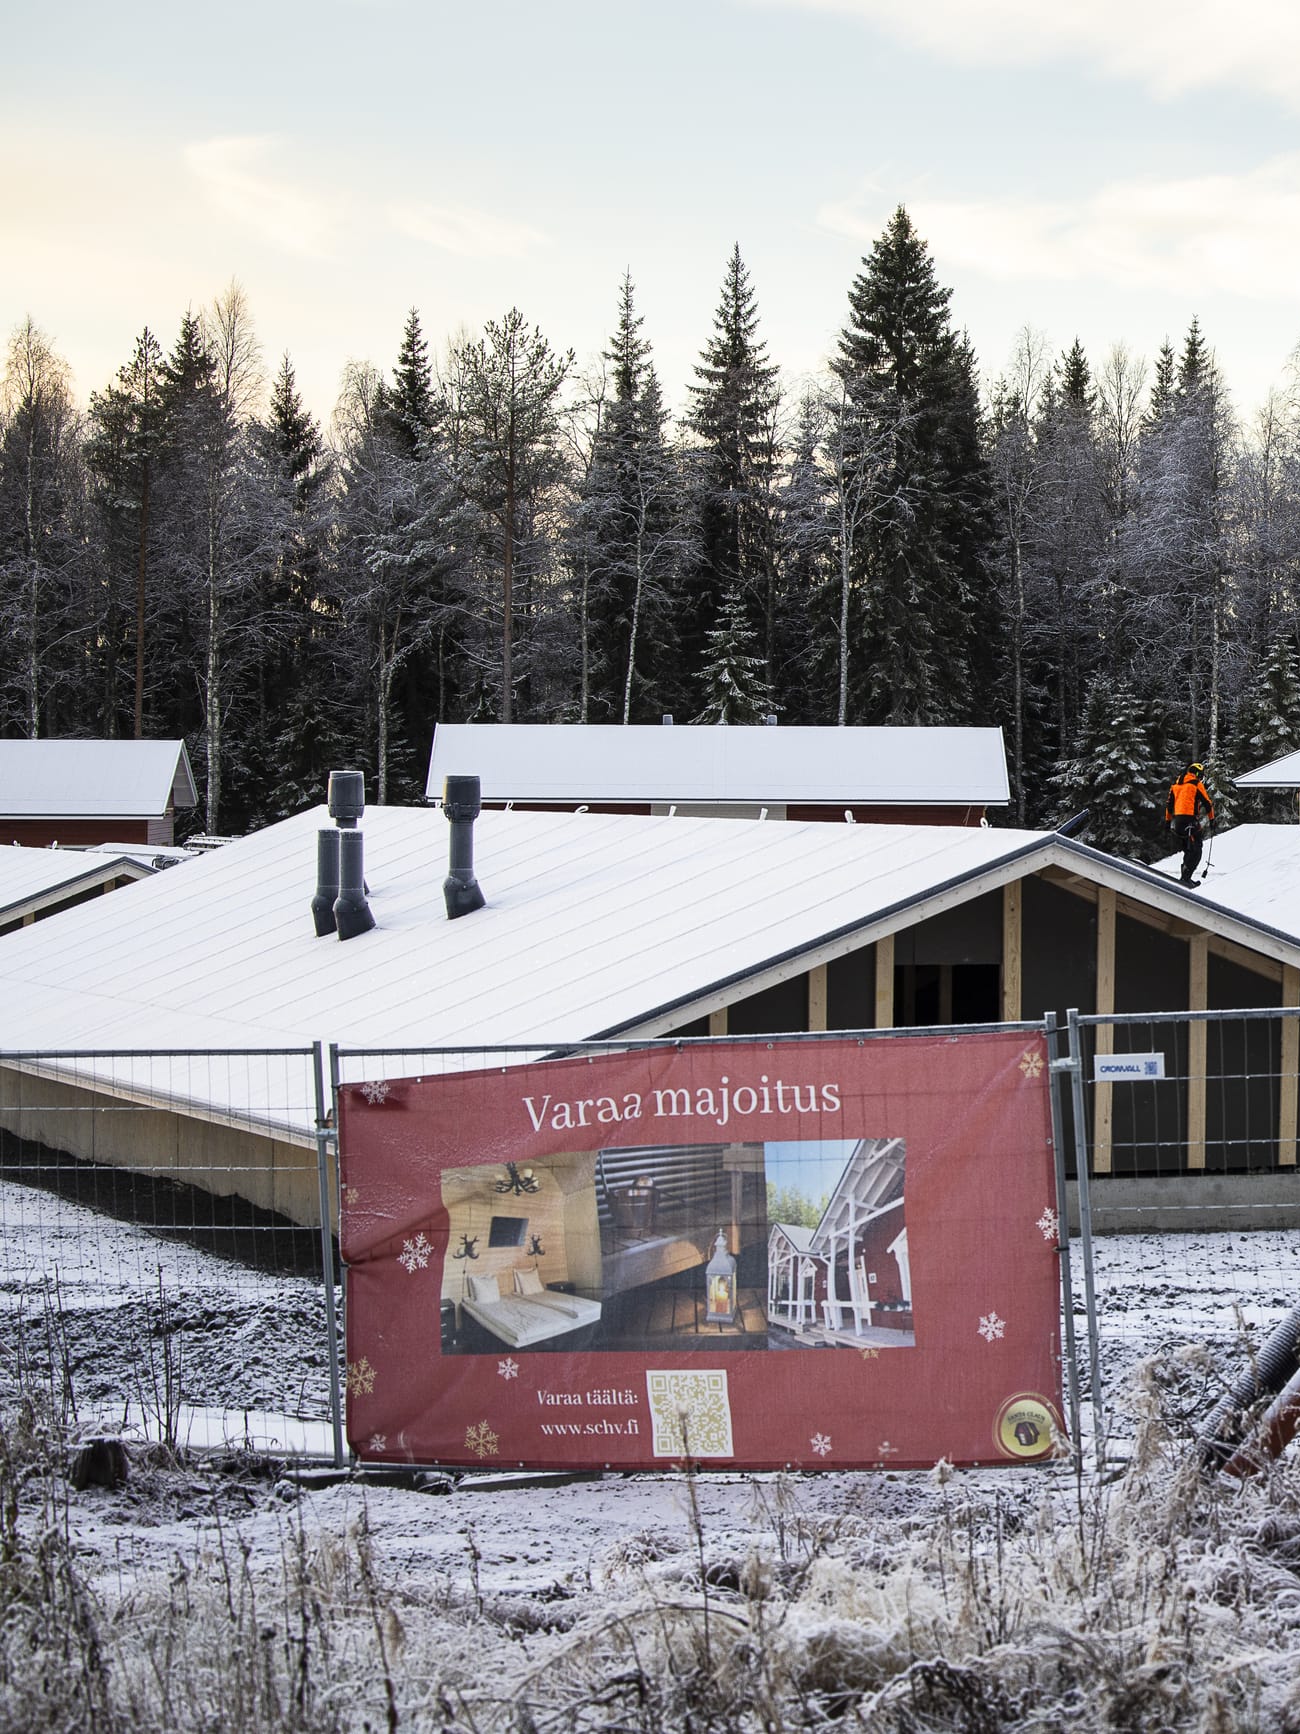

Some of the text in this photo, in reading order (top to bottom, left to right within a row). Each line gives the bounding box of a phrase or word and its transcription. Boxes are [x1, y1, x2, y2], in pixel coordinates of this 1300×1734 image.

[523, 1075, 841, 1131] Varaa majoitus
[537, 1390, 639, 1406] Varaa täältä:
[541, 1419, 639, 1435] www.schv.fi
